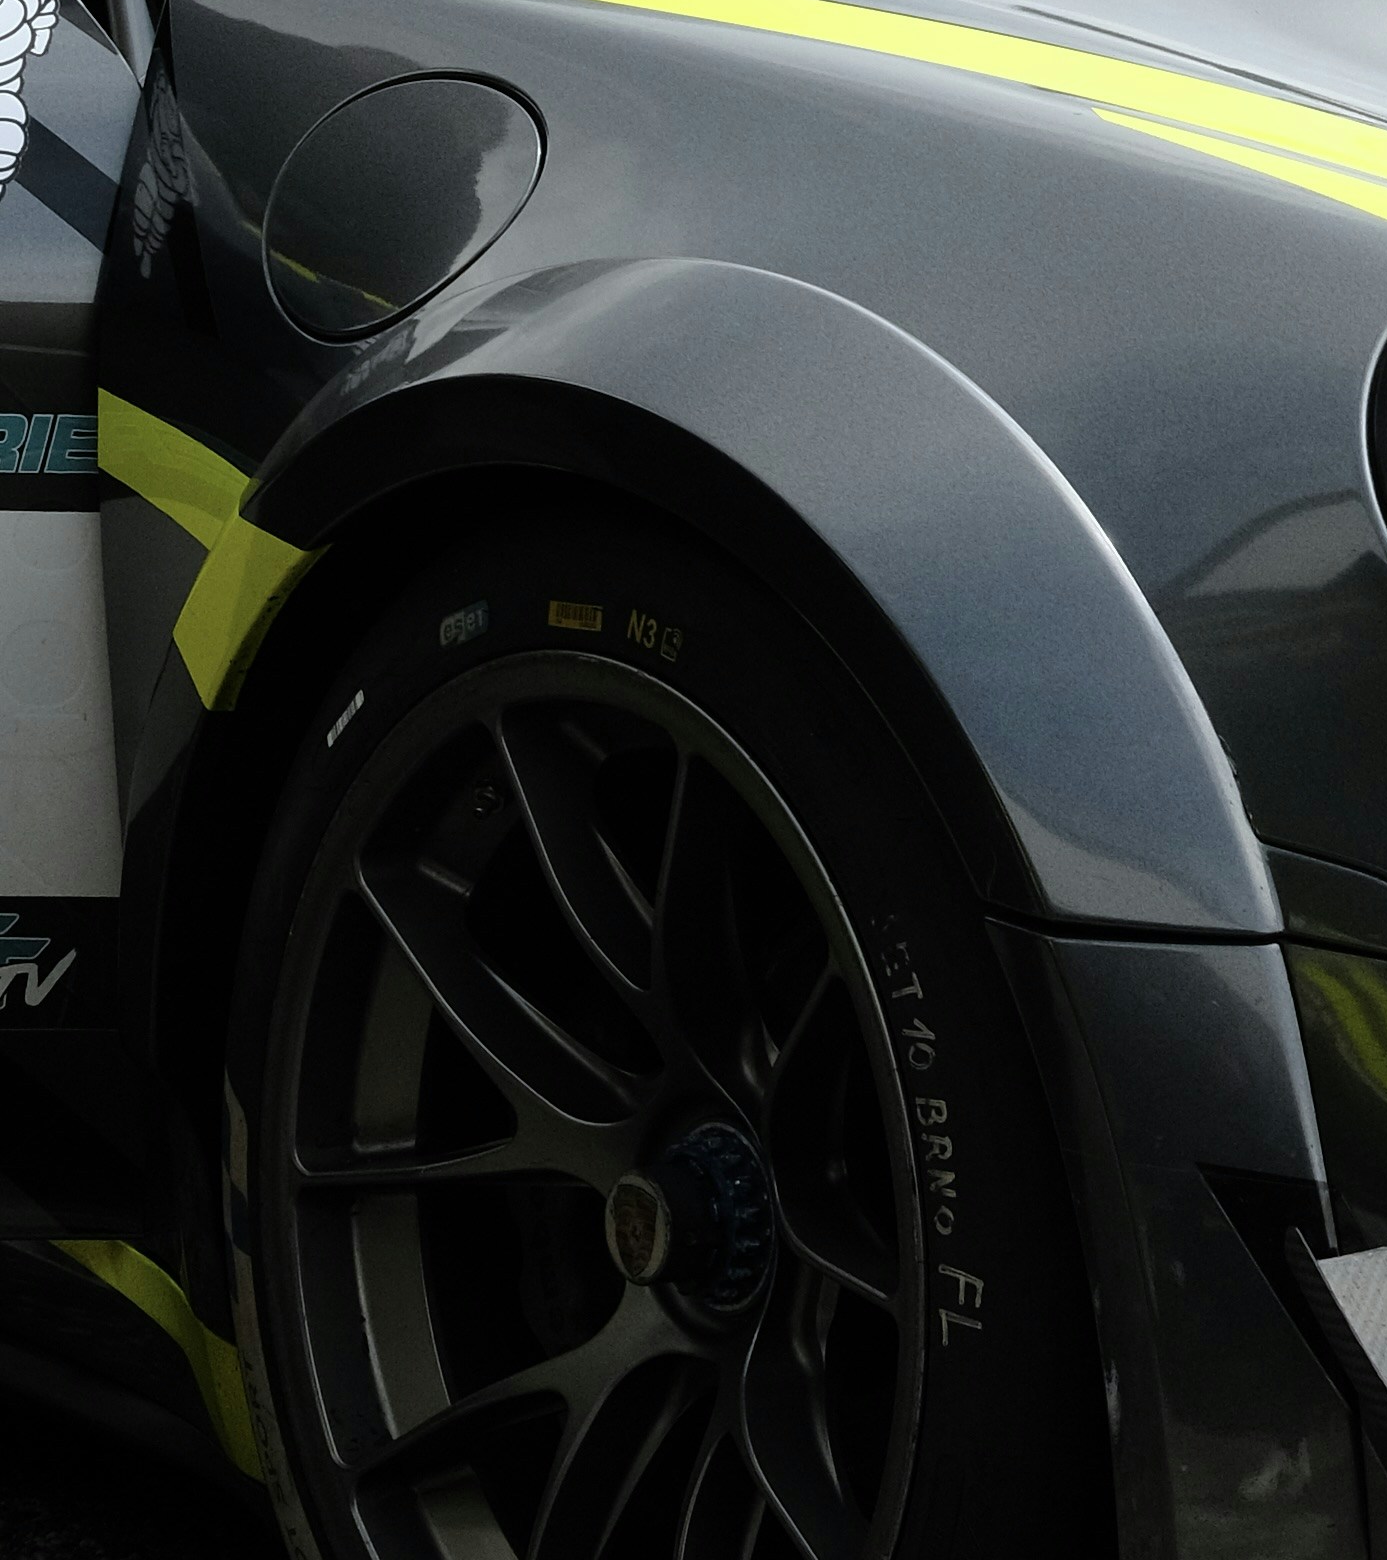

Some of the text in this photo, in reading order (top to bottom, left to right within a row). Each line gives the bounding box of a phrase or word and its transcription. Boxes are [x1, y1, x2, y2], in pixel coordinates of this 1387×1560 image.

[626, 608, 658, 649] N3
[901, 1017, 936, 1071] 10
[914, 1095, 958, 1237] BRNO
[937, 1262, 985, 1348] FL
